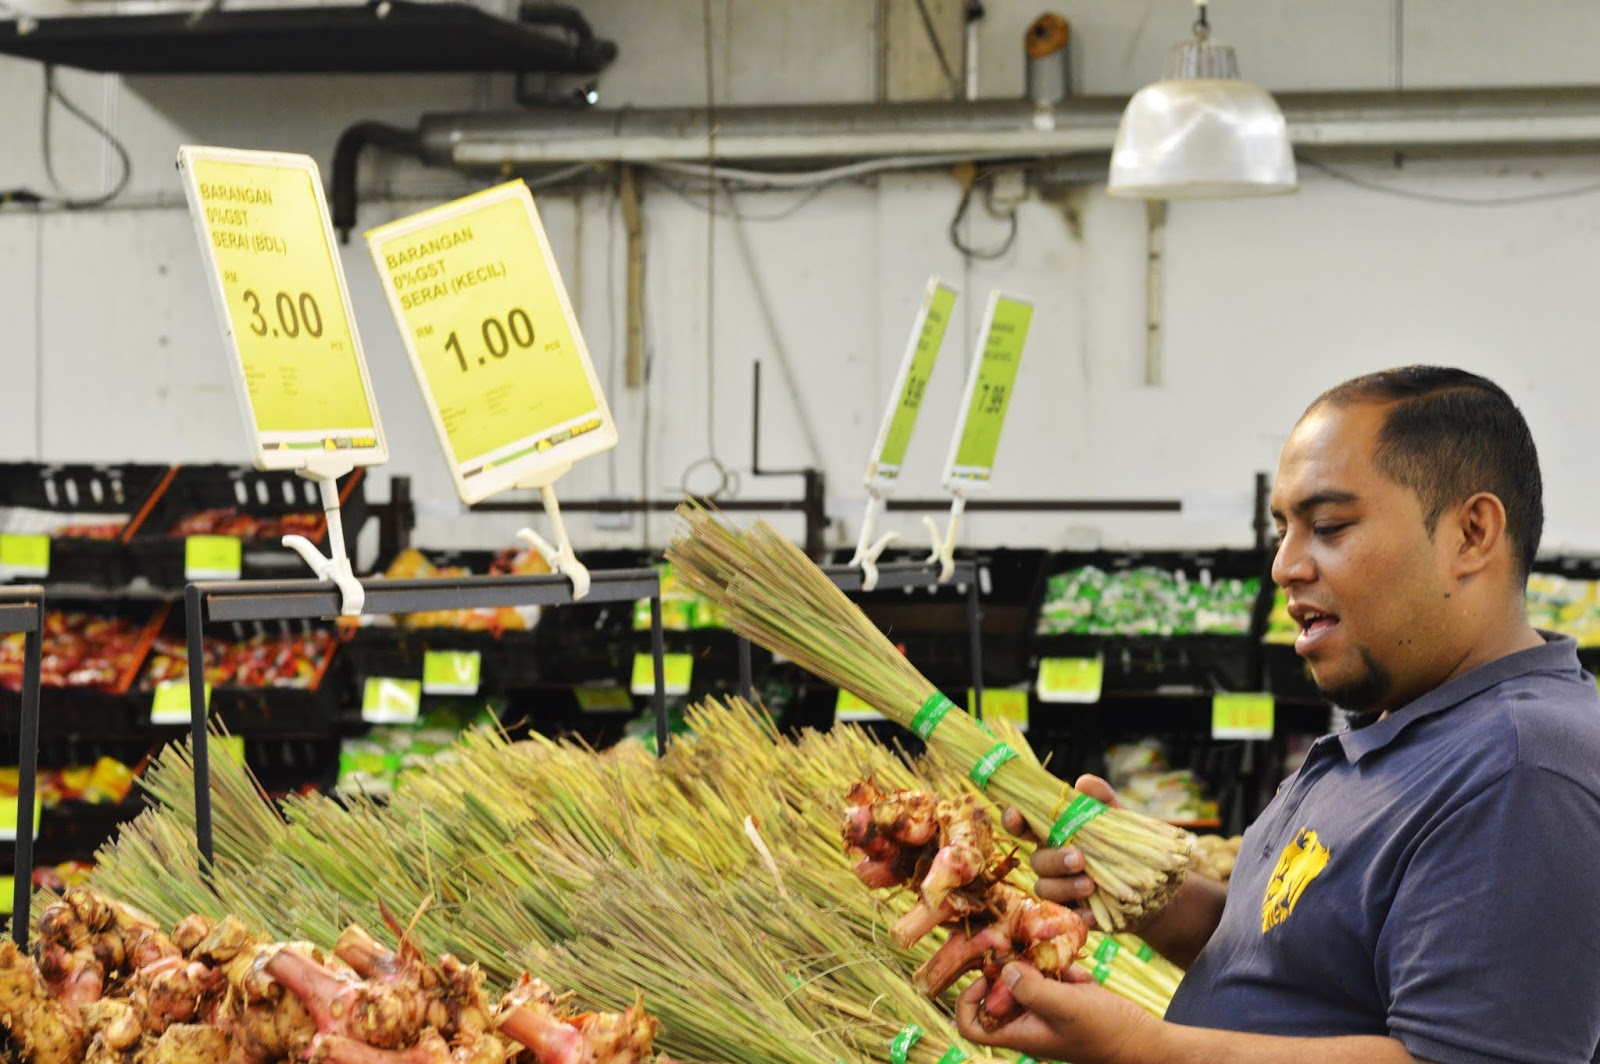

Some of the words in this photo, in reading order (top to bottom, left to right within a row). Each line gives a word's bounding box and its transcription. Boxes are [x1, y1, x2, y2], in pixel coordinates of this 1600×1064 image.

[200, 183, 273, 206] BARANGAN
[206, 208, 249, 227] 0%GST
[212, 230, 249, 249] SERAI
[251, 232, 287, 255] (BDL)
[385, 225, 475, 269] BARANGAN
[224, 269, 238, 282] RM
[393, 260, 448, 290] 0%GST
[400, 285, 449, 311] SERAI
[451, 261, 508, 296] (KECIL)
[243, 289, 323, 339] 3.00
[415, 324, 435, 339] RM
[443, 307, 536, 374] 1.00
